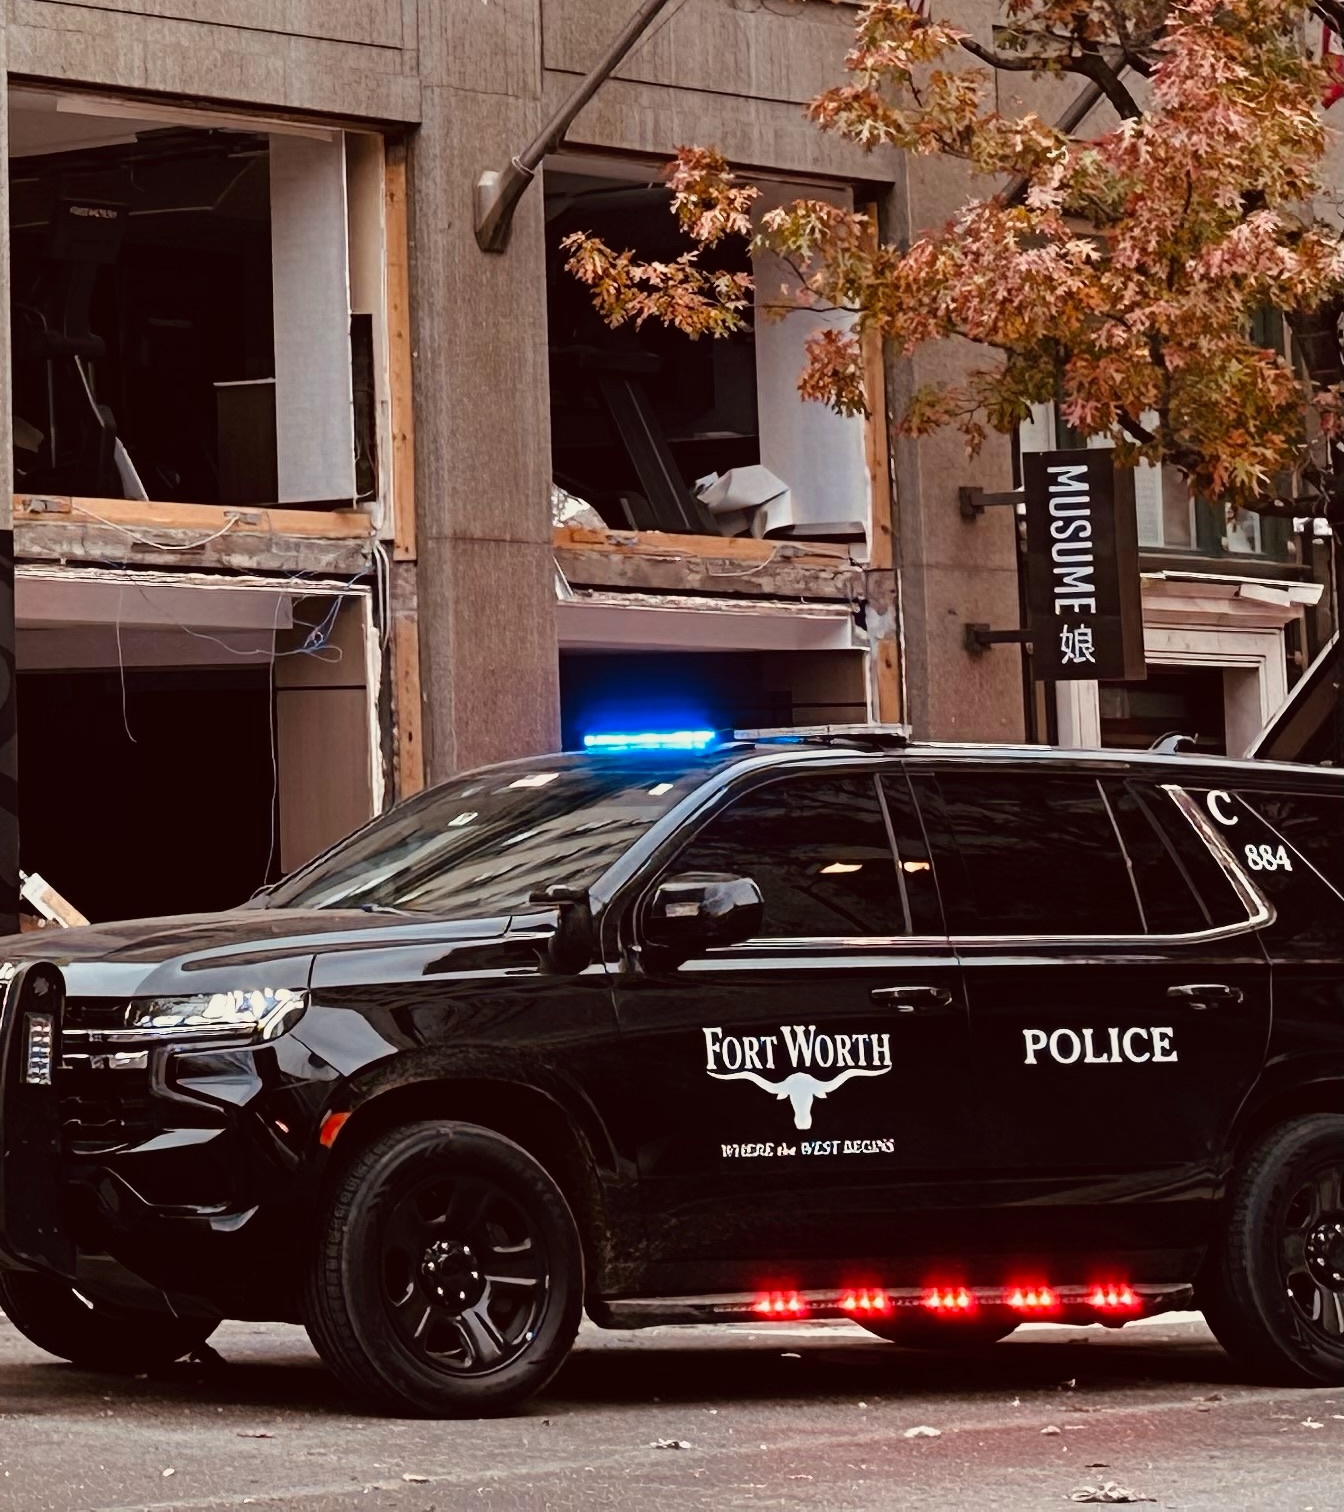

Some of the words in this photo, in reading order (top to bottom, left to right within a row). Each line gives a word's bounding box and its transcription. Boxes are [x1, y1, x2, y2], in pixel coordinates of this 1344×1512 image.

[1046, 464, 1097, 616] MUSUME
[1059, 623, 1096, 664] 娘
[1206, 790, 1239, 826] C
[1244, 843, 1294, 872] 884
[701, 1026, 778, 1070] FORT
[779, 1024, 893, 1068] WORTH
[1022, 1026, 1179, 1065] POLICE
